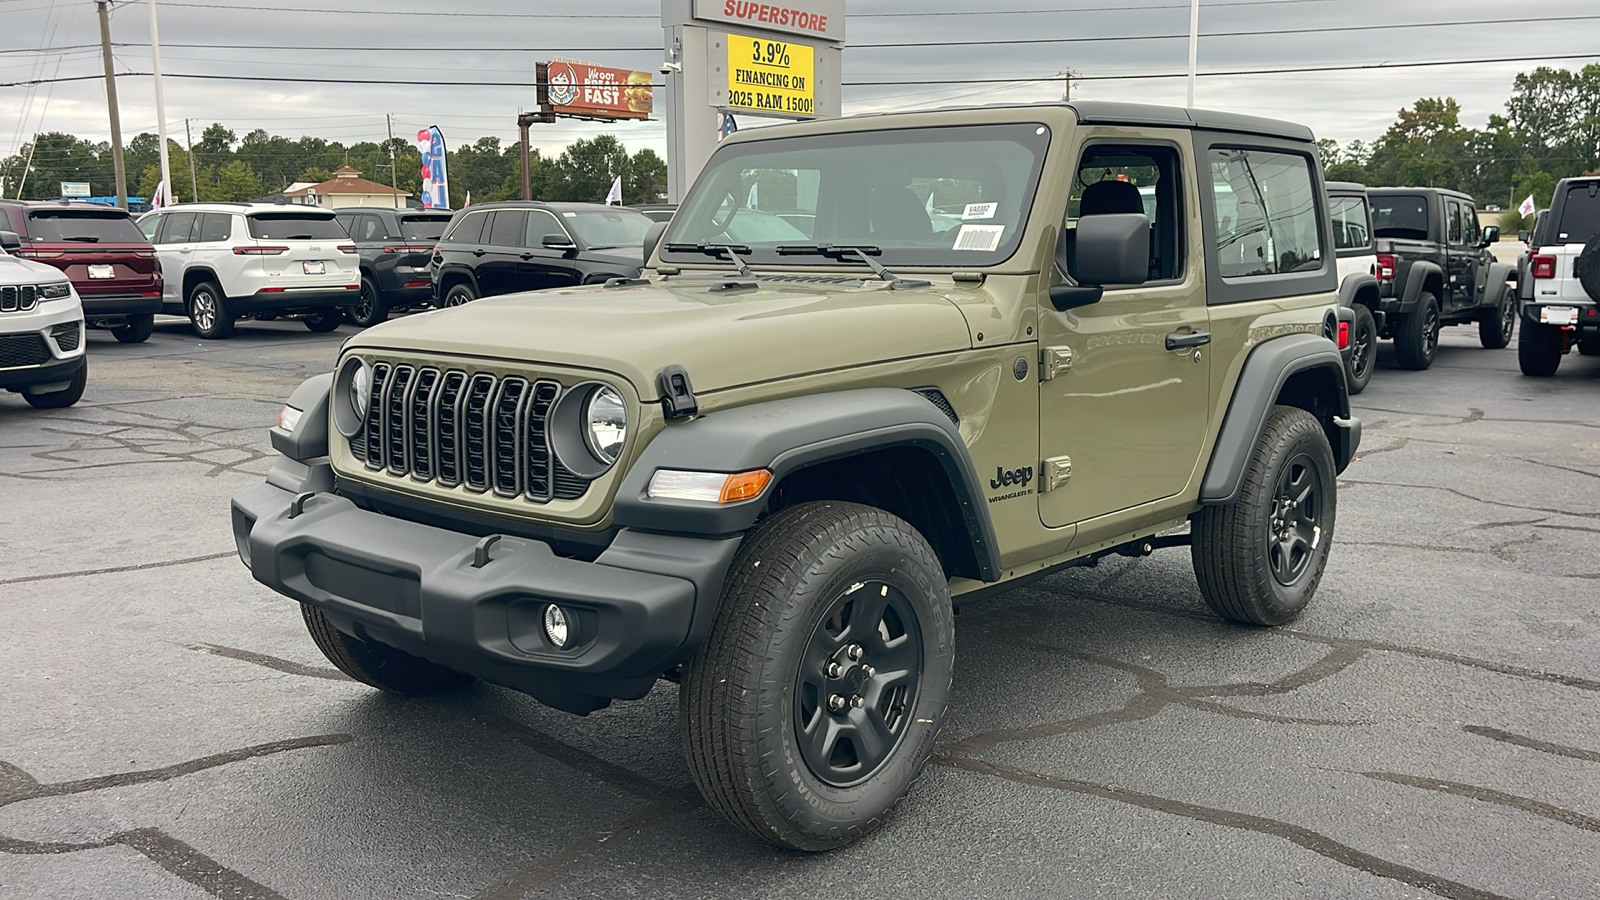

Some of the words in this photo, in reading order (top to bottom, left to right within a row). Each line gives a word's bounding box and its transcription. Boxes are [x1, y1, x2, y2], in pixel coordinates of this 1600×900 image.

[724, 0, 827, 32] SUPERSTORE
[753, 41, 790, 66] 3.9%
[585, 78, 619, 92] BREAK
[600, 72, 615, 81] GOT
[736, 69, 789, 88] FINANCING
[792, 76, 805, 90] ON
[585, 88, 620, 105] FAST
[729, 90, 753, 107] 2025
[756, 93, 782, 110] RAM
[787, 96, 813, 113] 1500!
[990, 466, 1033, 489] Jeep
[988, 490, 1027, 503] WRANGLER
[908, 559, 946, 643] NEXEN
